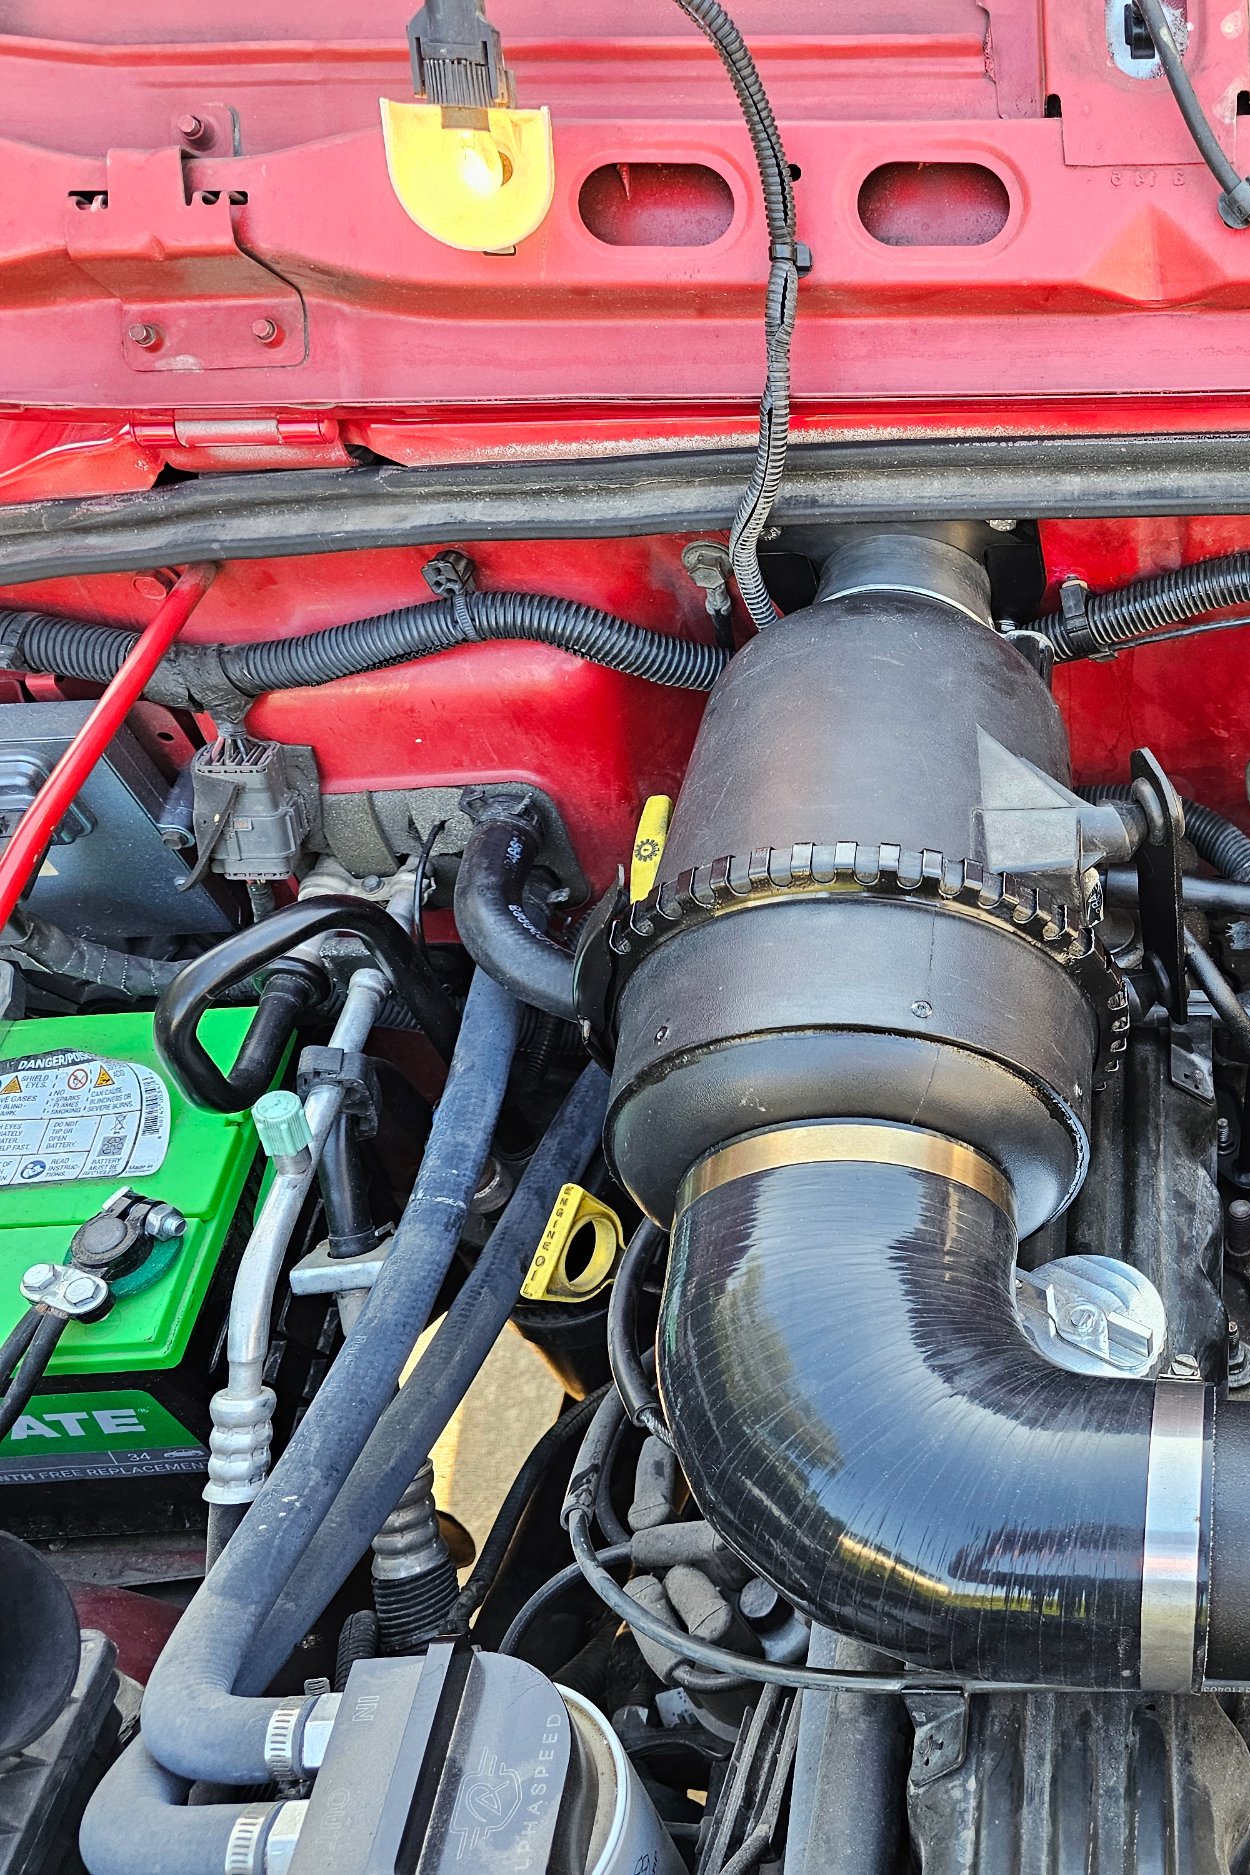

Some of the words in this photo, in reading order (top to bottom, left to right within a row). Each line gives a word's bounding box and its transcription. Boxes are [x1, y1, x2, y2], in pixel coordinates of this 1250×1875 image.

[21, 1074, 50, 1082] SHIELD
[90, 1089, 104, 1098] CAN
[104, 1086, 123, 1096] CAUSE
[11, 1095, 38, 1103] GASES
[55, 1094, 81, 1103] SPARKS
[89, 1095, 123, 1105] BLINDNESS
[123, 1092, 132, 1100] OR
[50, 1107, 81, 1115] SMOKING
[87, 1104, 111, 1112] SEVERE
[63, 1127, 74, 1135] OR
[12, 1143, 31, 1151] FAST.
[45, 1141, 78, 1149] BATTERY.
[50, 1157, 70, 1165] READ
[91, 1156, 123, 1165] BATTERY
[541, 1185, 575, 1252] ENGINE
[522, 1255, 546, 1298] OIL
[127, 1451, 152, 1462] 34
[38, 1468, 84, 1480] FREE
[351, 1693, 381, 1723] IN
[513, 1712, 562, 1873] LPHASPEED
